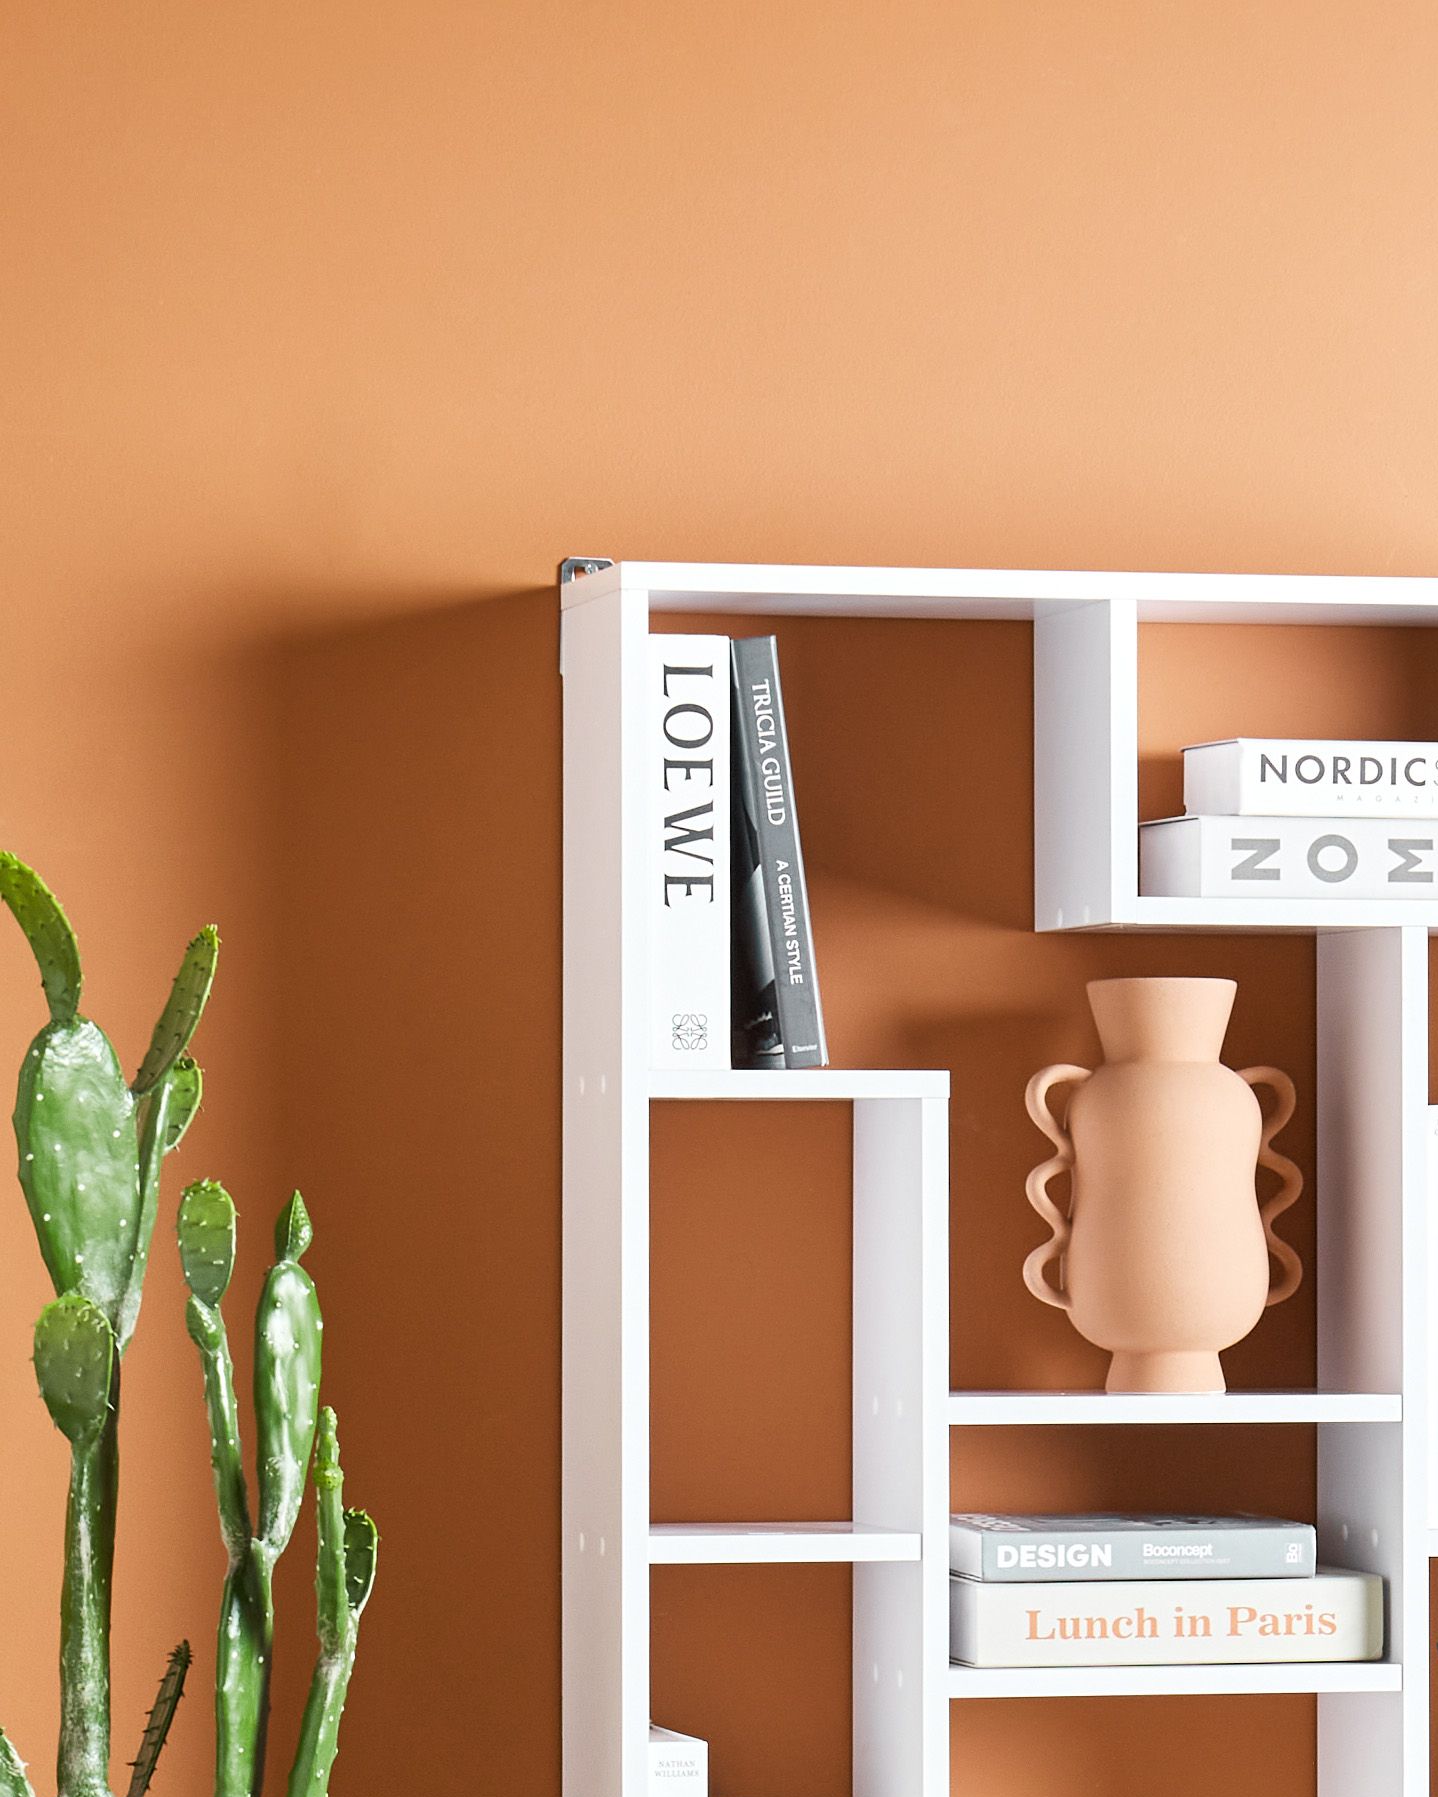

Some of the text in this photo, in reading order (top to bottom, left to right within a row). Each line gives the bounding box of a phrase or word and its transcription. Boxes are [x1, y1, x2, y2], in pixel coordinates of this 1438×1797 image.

[751, 678, 787, 827] TRICIA GUILD
[663, 663, 714, 907] LOEWE
[776, 860, 804, 985] A CERTIAN STYLE
[997, 1543, 1112, 1569] DESIGN
[1143, 1543, 1213, 1558] Boconcept
[1025, 1604, 1337, 1641] Lunch in Paris
[654, 1769, 700, 1778] WILLIAMS
[658, 1760, 696, 1768] NATHAN
